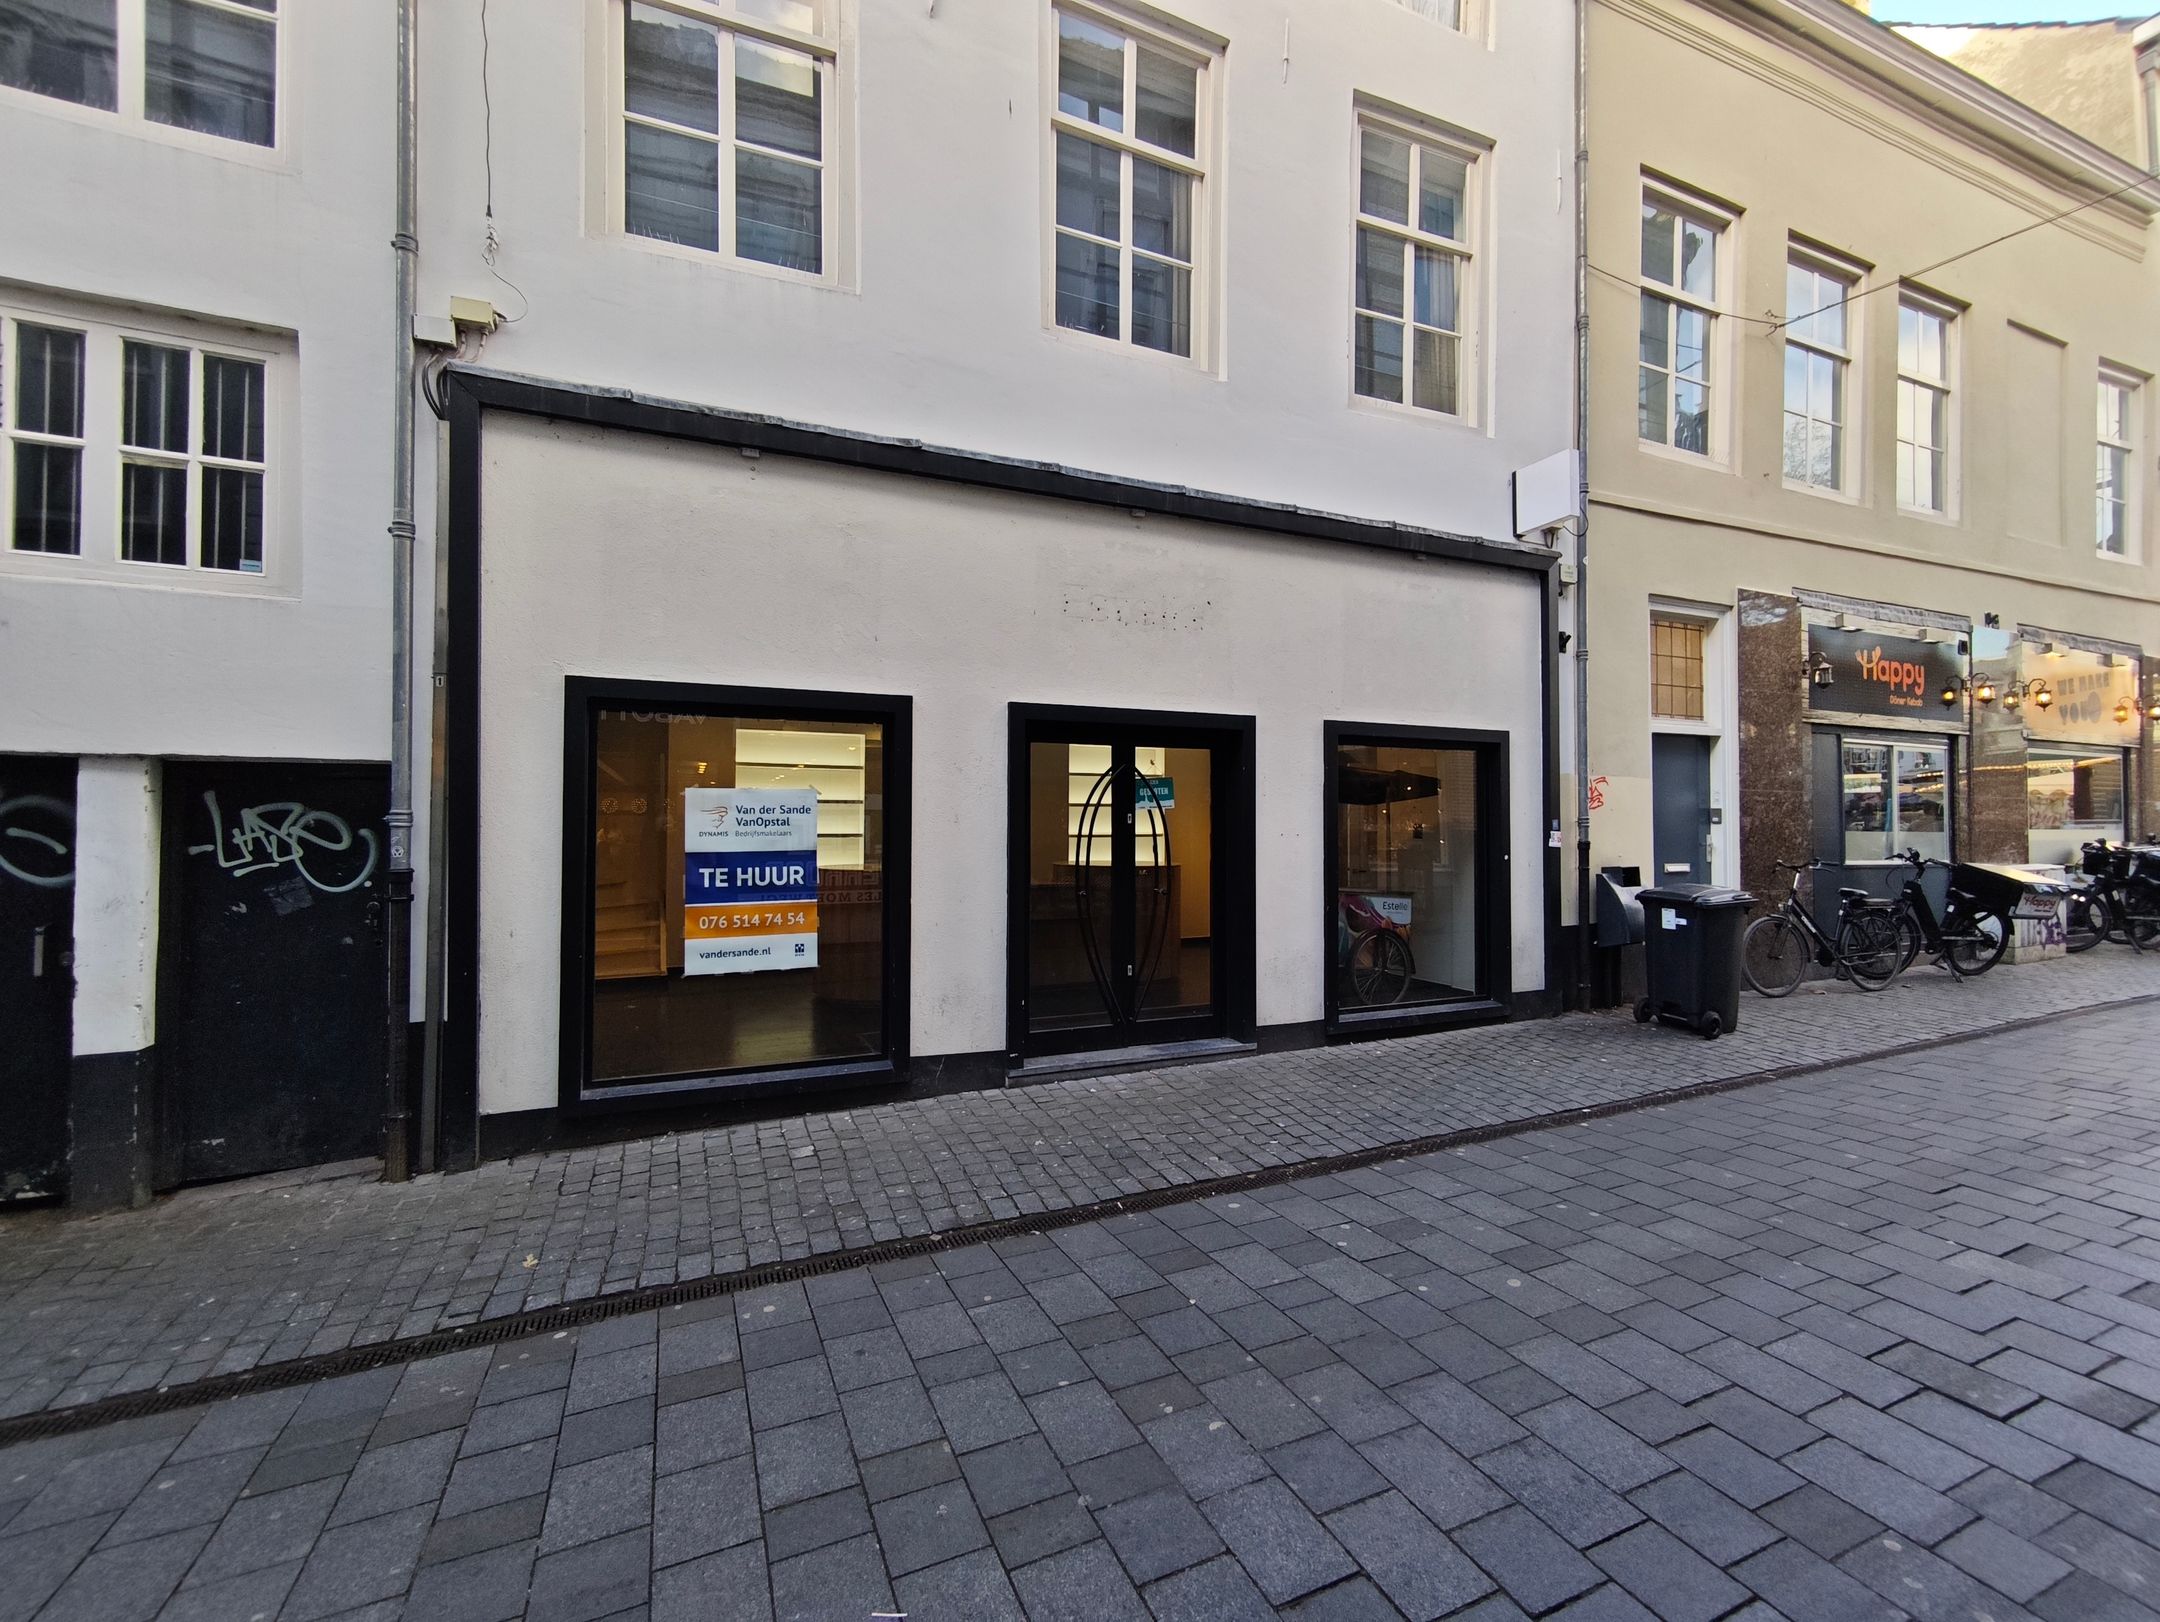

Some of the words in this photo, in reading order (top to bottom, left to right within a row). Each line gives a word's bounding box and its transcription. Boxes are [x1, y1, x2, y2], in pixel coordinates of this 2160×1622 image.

[1855, 646, 1925, 696] Happy
[735, 805, 756, 815] Van
[758, 805, 777, 815] der
[779, 805, 812, 815] Sande
[735, 817, 791, 828] VanOpstal
[735, 830, 793, 838] Bedrijfsmakelaars
[699, 867, 729, 888] TE
[736, 865, 805, 887] HUUR
[699, 916, 728, 930] 076
[732, 914, 760, 928] 514
[764, 912, 783, 926] 74
[787, 911, 805, 925] 54
[699, 946, 772, 960] vandersande.nl
